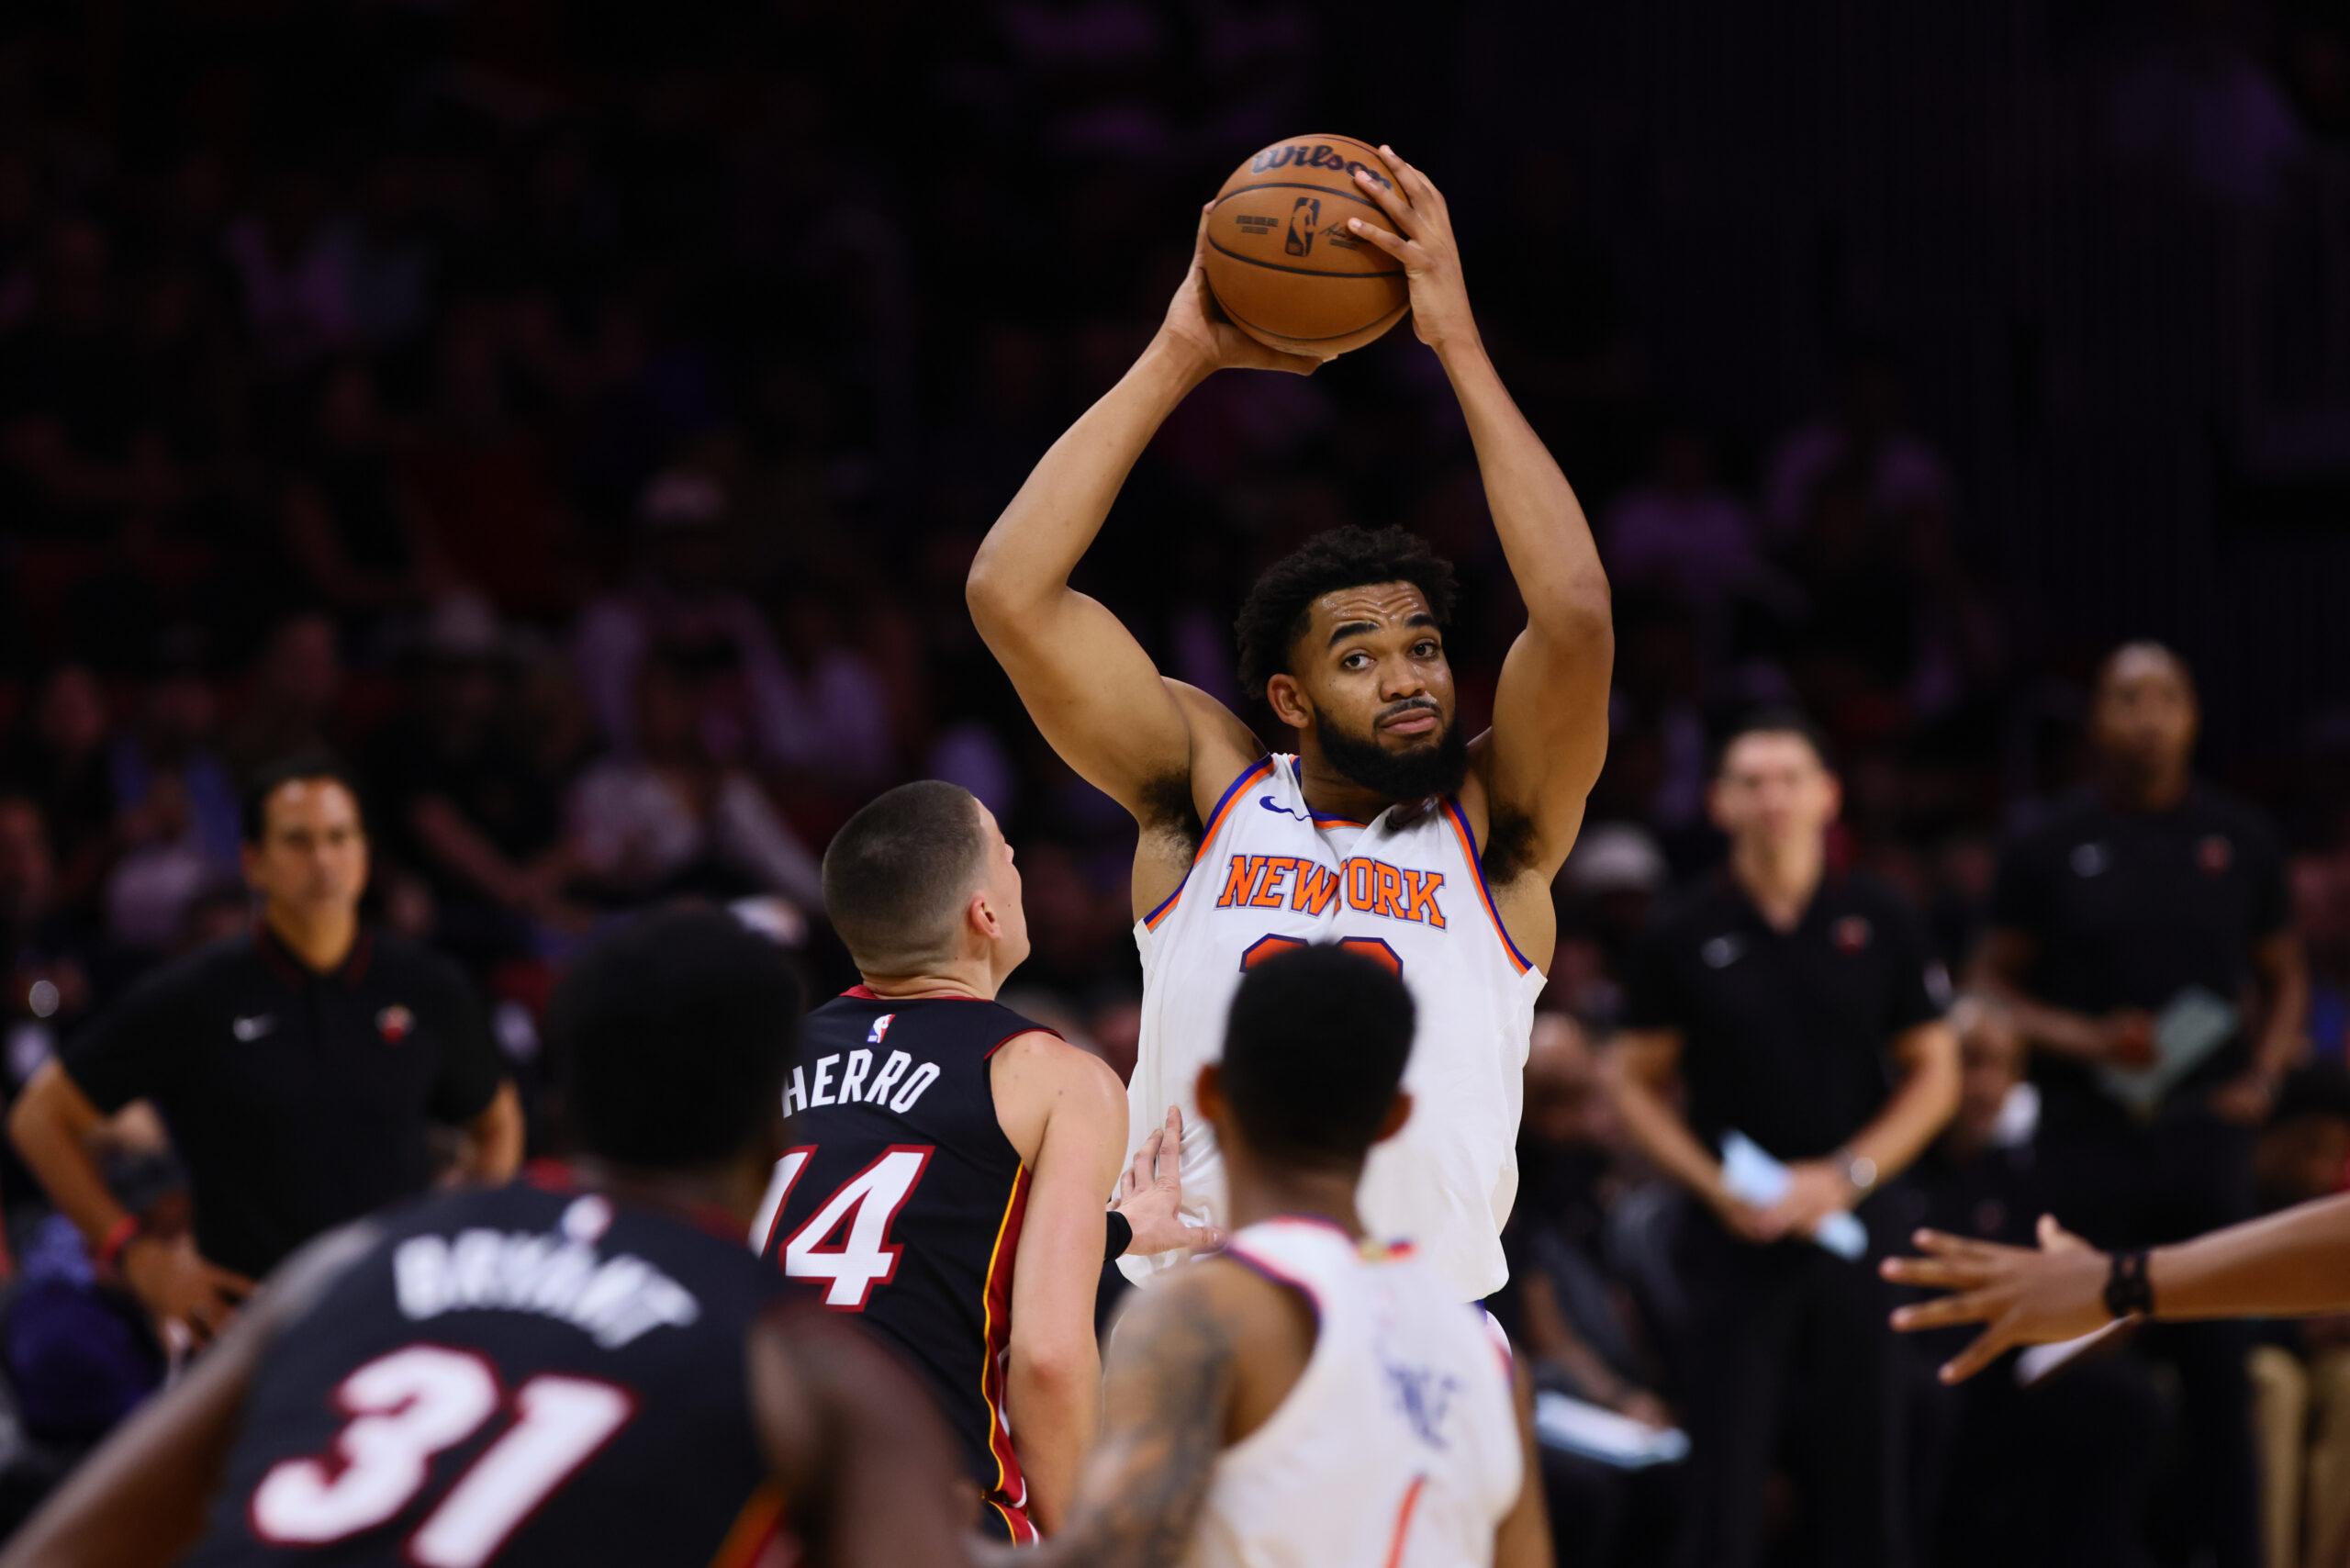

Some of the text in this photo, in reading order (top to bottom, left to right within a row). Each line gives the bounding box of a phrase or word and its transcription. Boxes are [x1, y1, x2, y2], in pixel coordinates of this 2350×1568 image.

[1214, 853, 1339, 919] NEW
[781, 1048, 940, 1119] HERRO
[246, 1341, 639, 1568] 31
